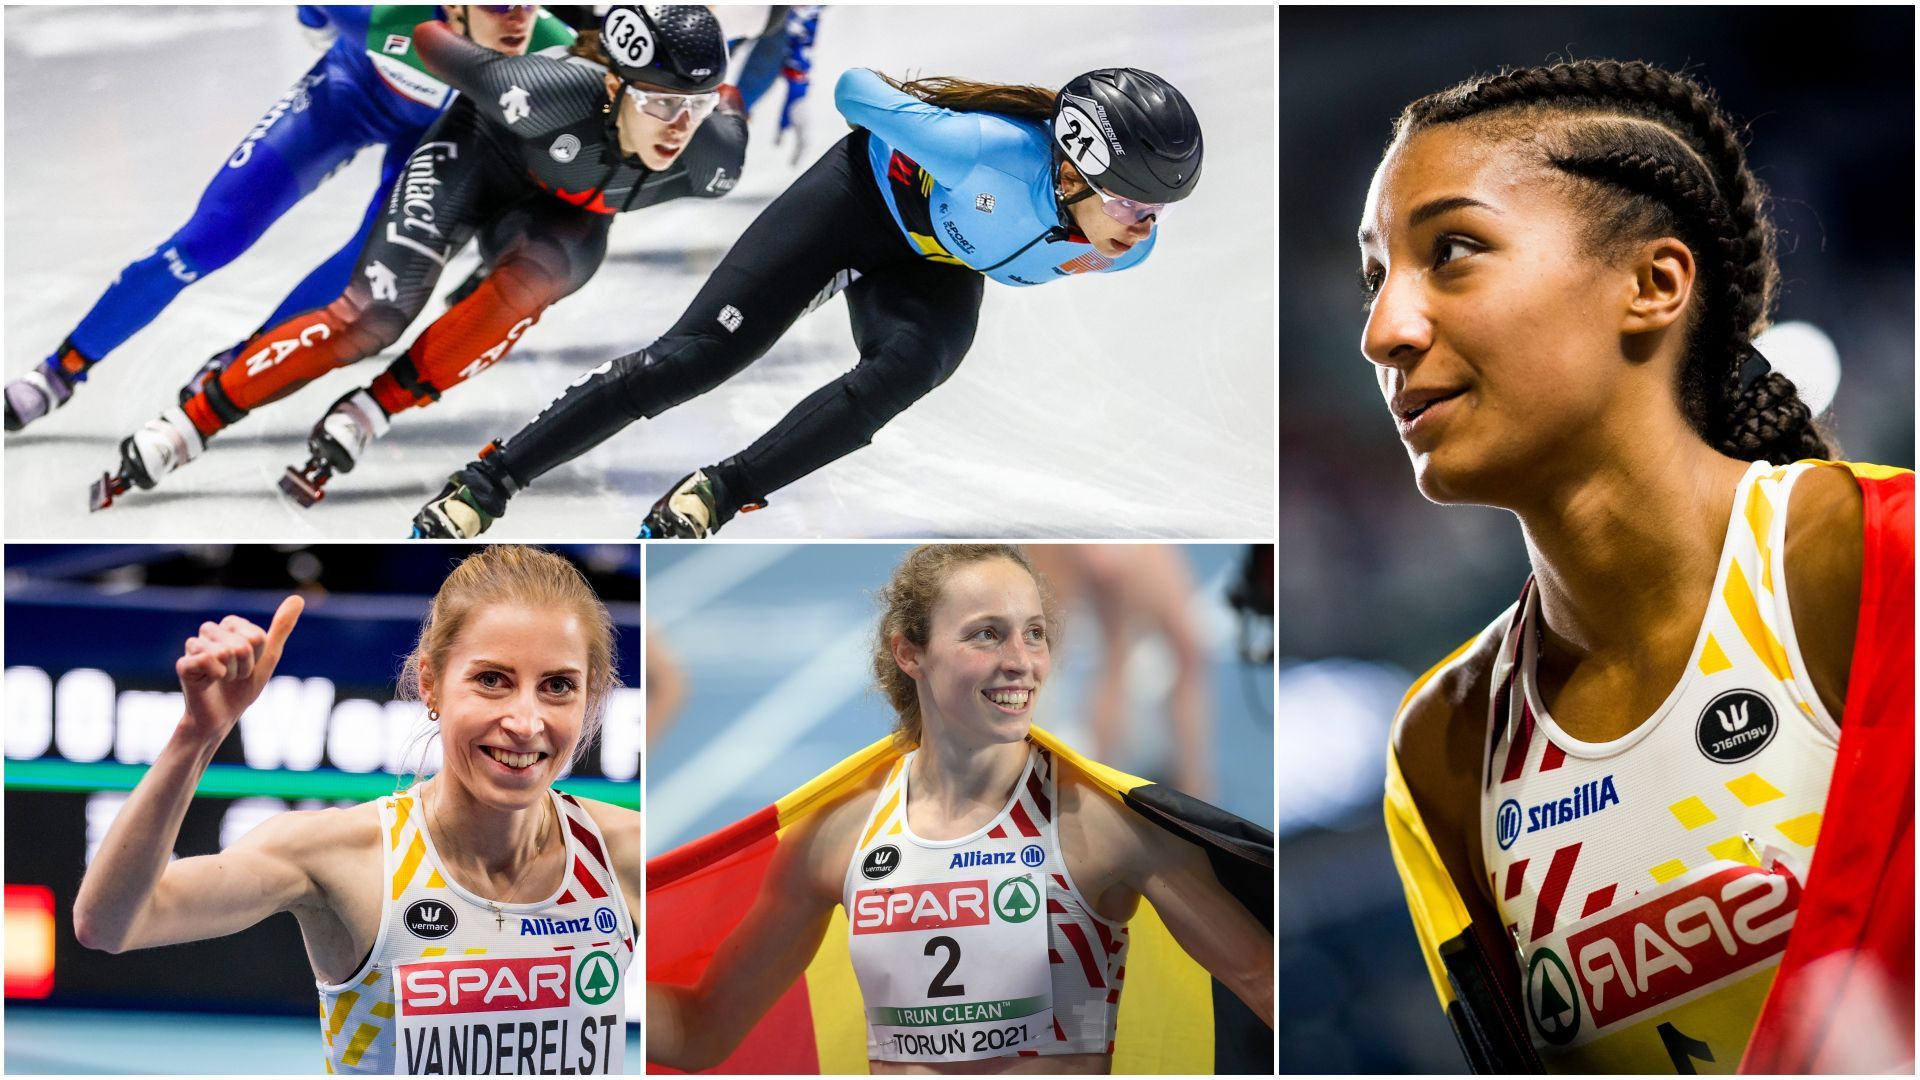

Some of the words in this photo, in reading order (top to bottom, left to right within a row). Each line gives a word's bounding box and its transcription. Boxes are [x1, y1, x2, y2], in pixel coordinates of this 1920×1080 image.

[610, 15, 648, 61] 136
[1060, 120, 1095, 162] 21
[1096, 105, 1126, 156] POWERSLIDE
[245, 323, 331, 377] CAN
[458, 317, 533, 378] CAN
[865, 864, 893, 873] vermarc
[949, 851, 1016, 869] Allianz
[411, 922, 449, 932] vermarc
[520, 917, 592, 936] Allianz
[857, 886, 985, 928] SPAR
[406, 964, 566, 1007] SPAR
[923, 935, 965, 999] 2
[904, 1008, 938, 1025] RUN
[404, 1014, 617, 1075] VANDERELST
[894, 1029, 966, 1056] TORUŃ
[972, 1024, 1028, 1053] 2021
